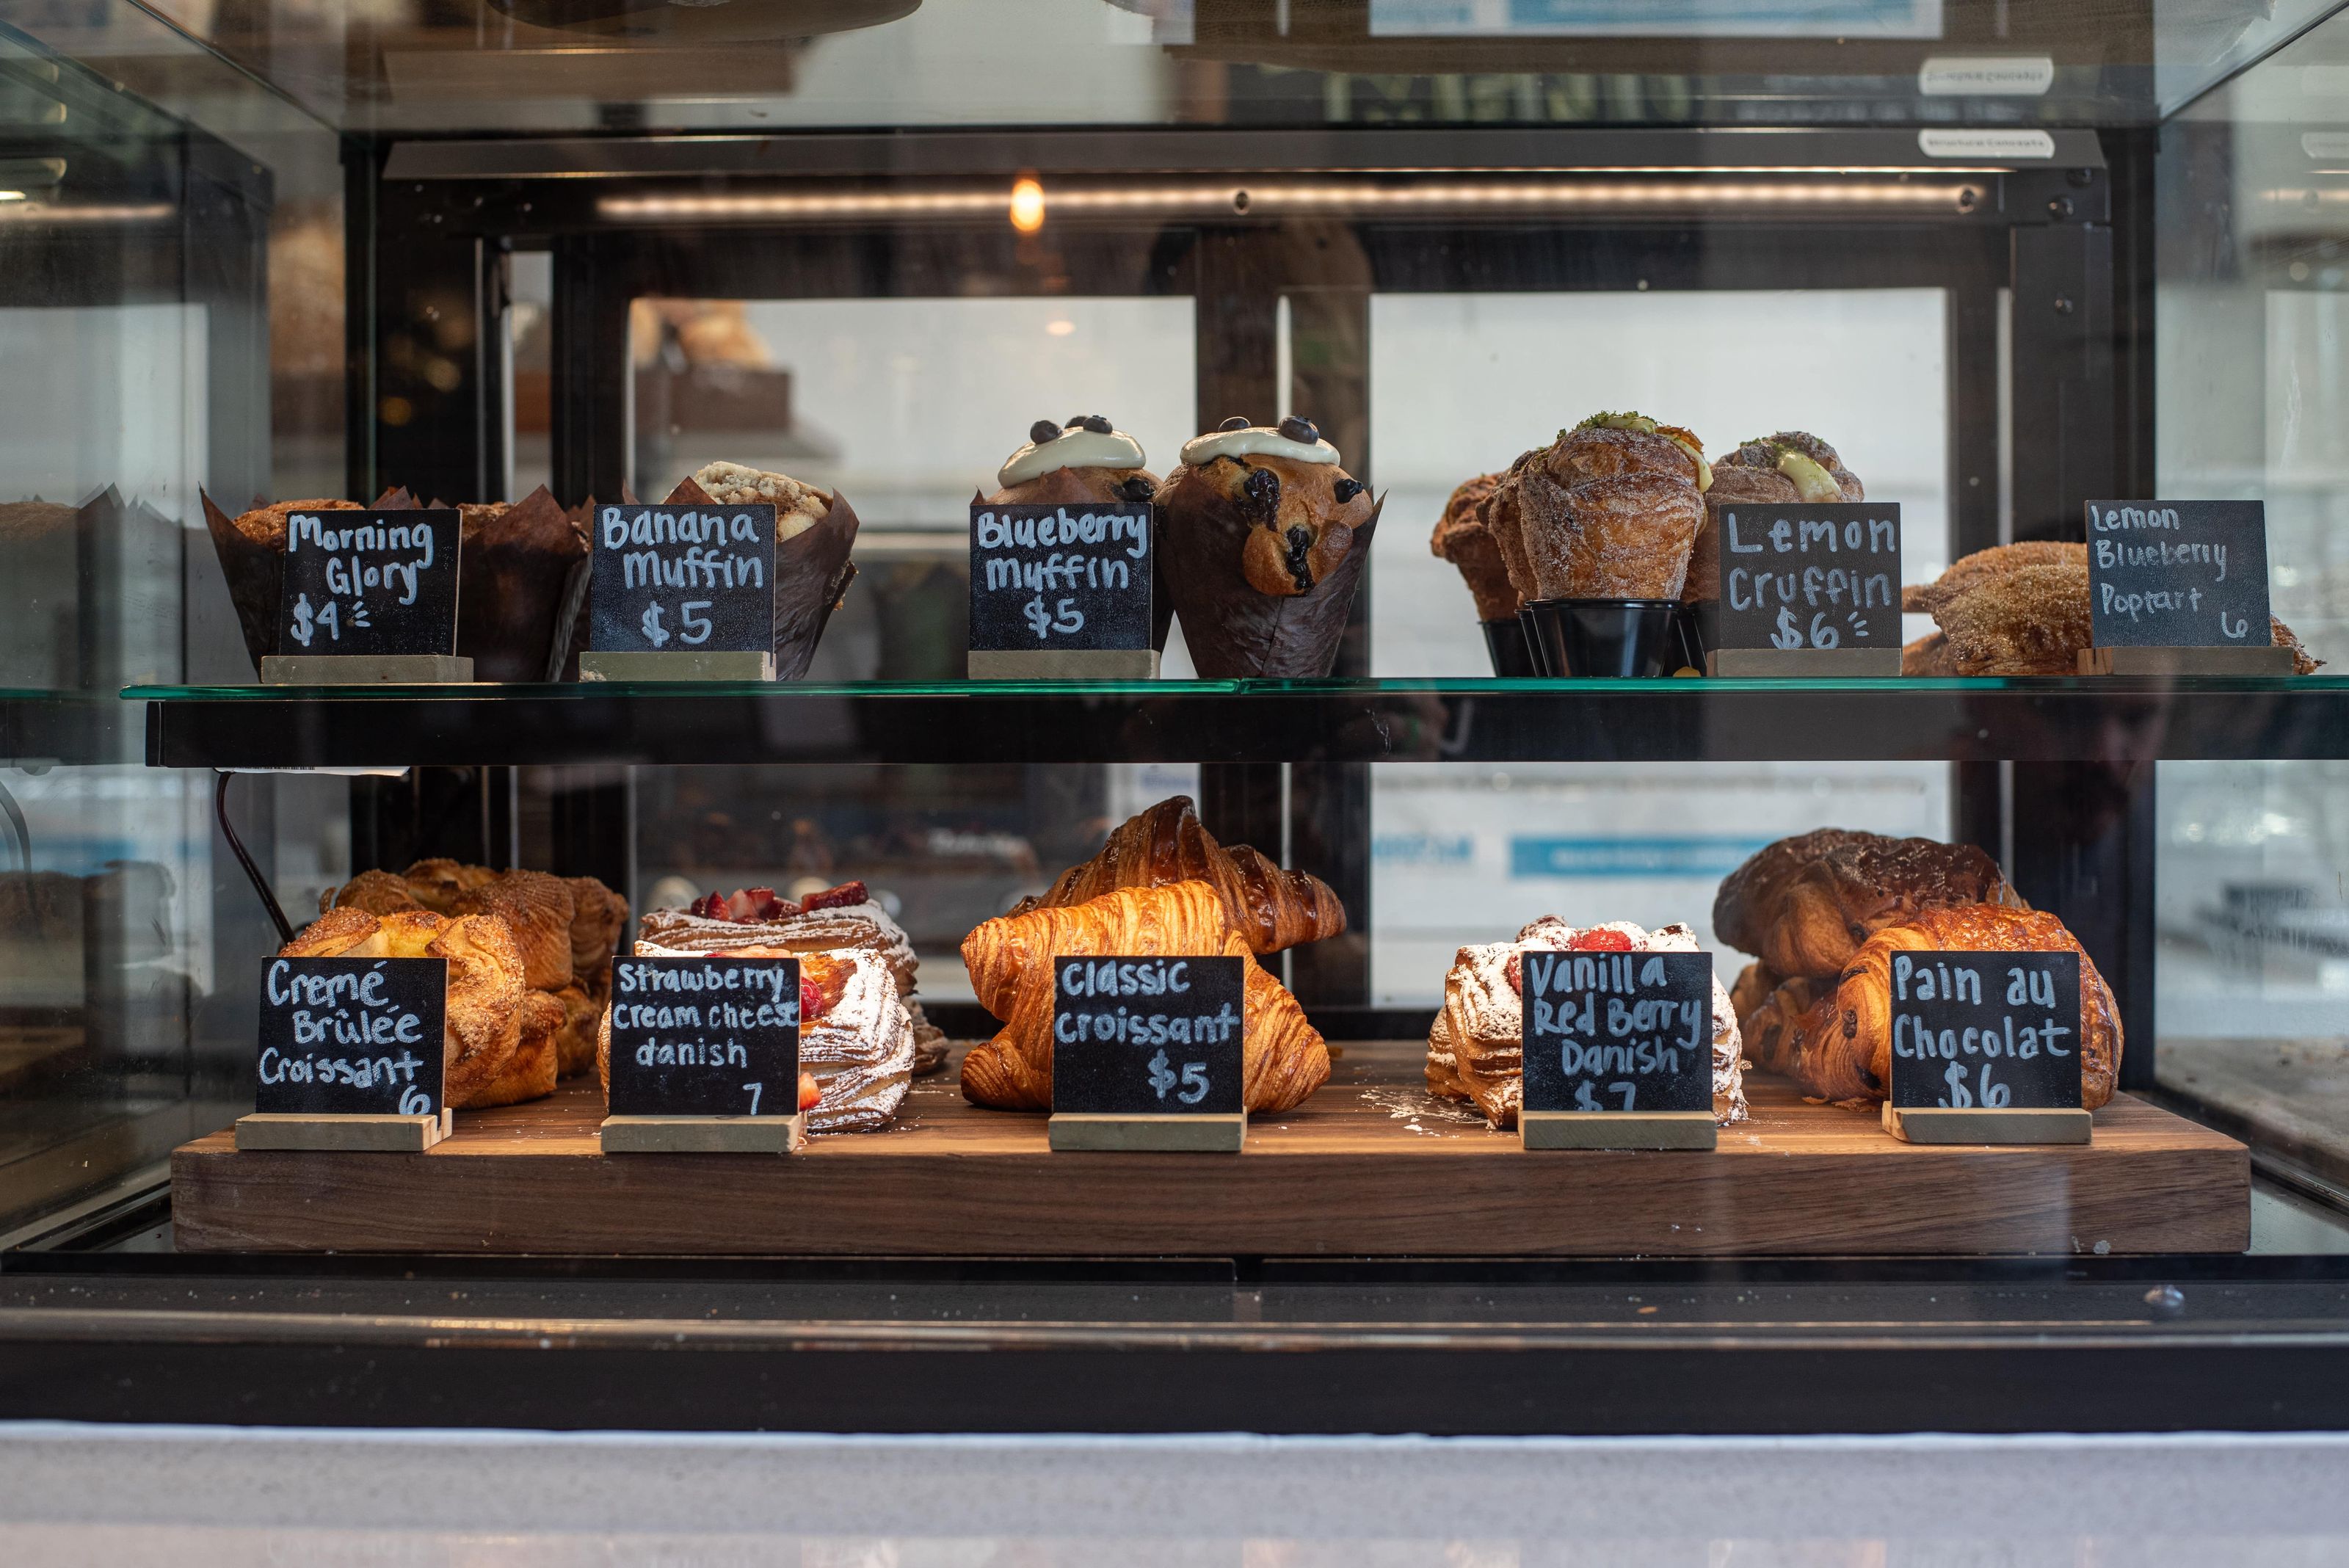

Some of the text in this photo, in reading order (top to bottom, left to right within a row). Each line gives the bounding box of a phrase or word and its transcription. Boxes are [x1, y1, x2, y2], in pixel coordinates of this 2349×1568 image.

[602, 507, 760, 551] Banana
[978, 507, 1147, 559] Blueberry
[1728, 512, 1895, 553] Lemon
[2091, 505, 2179, 531] Lemon
[288, 515, 434, 569] Morning
[2096, 540, 2226, 582] Blueberry
[326, 555, 418, 606] Glory
[1729, 566, 1891, 611] Cruffin
[1023, 595, 1084, 639] $5
[2100, 582, 2202, 623] Poptart
[2221, 611, 2248, 639] 6
[618, 963, 785, 1003] Strawberry
[1530, 953, 1667, 997] Vanilla
[1895, 955, 2055, 1009] Pain au
[293, 1005, 423, 1045] Brûlée
[1533, 992, 1702, 1050] Red Berry
[1894, 1013, 2072, 1060] Chocolat
[259, 1047, 424, 1089] Croissant
[635, 1037, 747, 1069] danish
[1561, 1035, 1679, 1076] Danish
[1147, 1048, 1210, 1103] $5
[1938, 1061, 2011, 1108] $6
[399, 1085, 431, 1115] 6
[742, 1082, 763, 1116] 7
